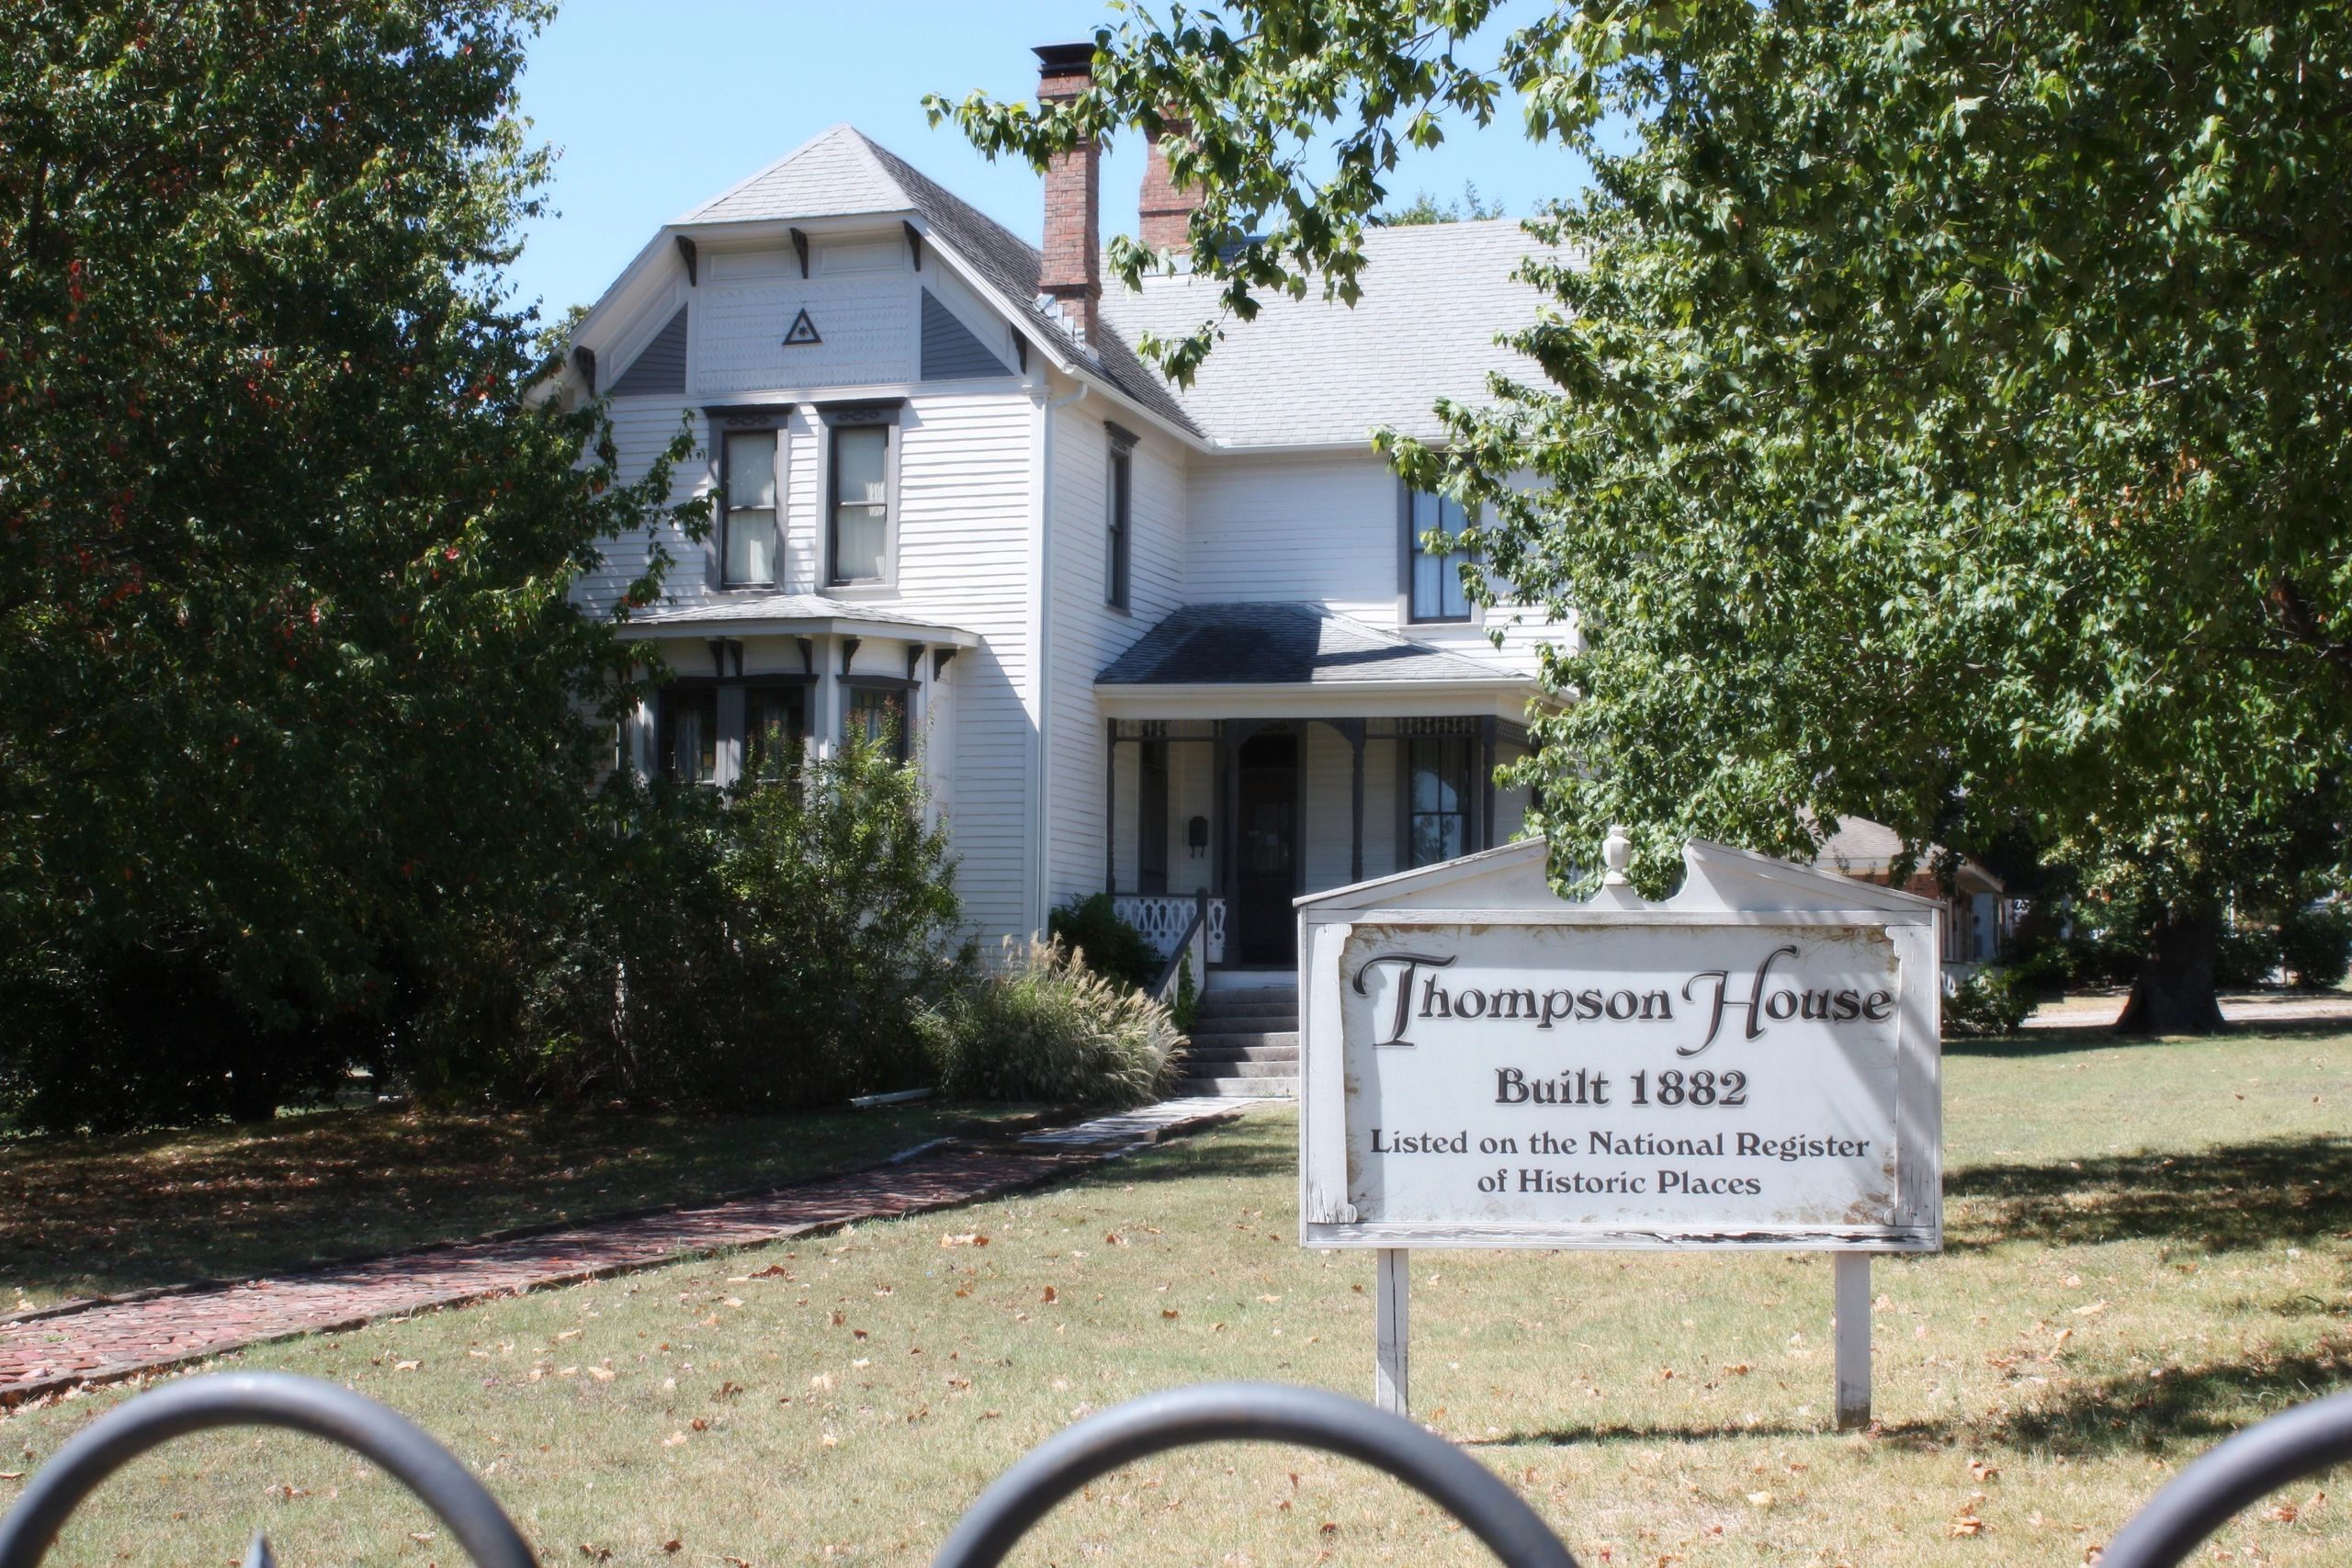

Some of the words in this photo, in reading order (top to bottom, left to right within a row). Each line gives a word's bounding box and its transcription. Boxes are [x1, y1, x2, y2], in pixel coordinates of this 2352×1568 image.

[1353, 952, 1675, 1047] Thompson
[1677, 945, 1893, 1057] House
[1495, 1066, 1611, 1105] Built
[1630, 1067, 1748, 1106] 1882
[1371, 1129, 1468, 1155] Listed
[1479, 1137, 1519, 1155] on
[1529, 1130, 1578, 1156] the
[1589, 1131, 1724, 1156] National
[1736, 1132, 1871, 1162] Register
[1477, 1168, 1507, 1193] of
[1517, 1168, 1646, 1194] Historic
[1657, 1170, 1762, 1196] Places
